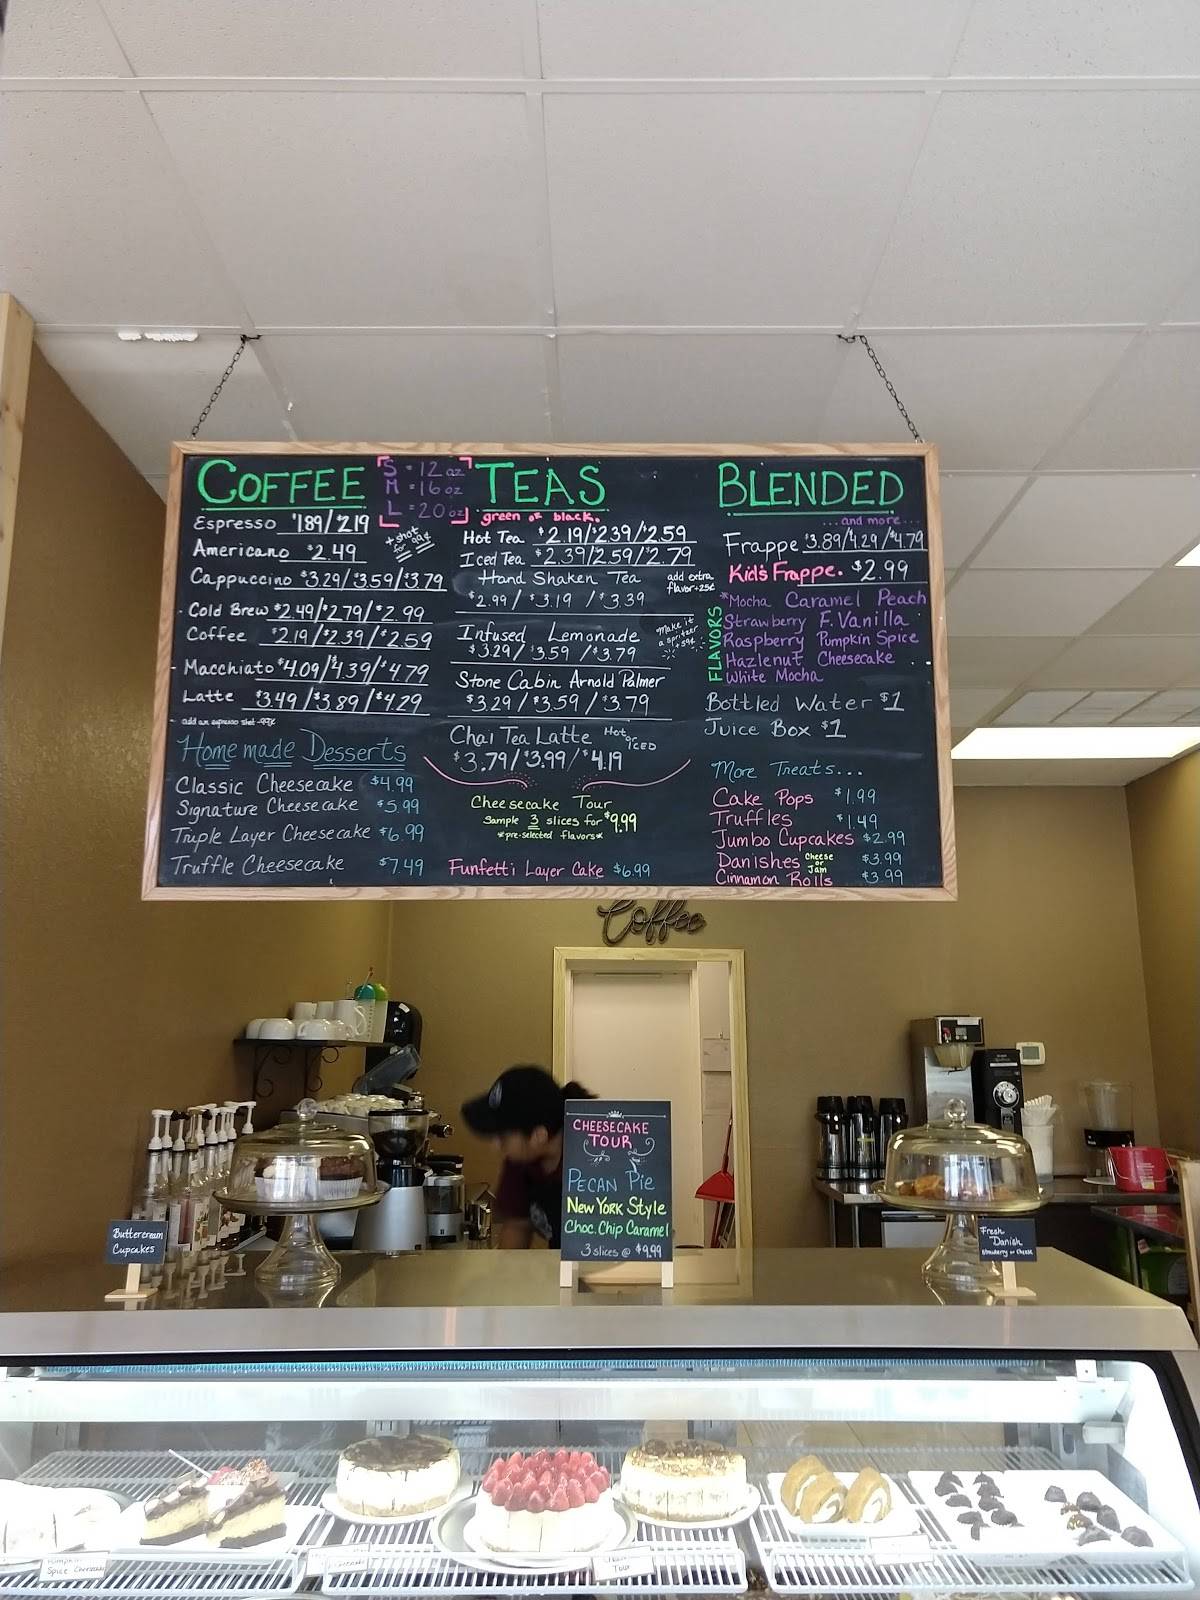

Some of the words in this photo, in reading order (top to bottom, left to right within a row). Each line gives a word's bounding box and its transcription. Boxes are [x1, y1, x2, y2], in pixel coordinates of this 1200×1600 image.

[384, 459, 397, 477] S
[421, 461, 443, 477] 12
[446, 468, 465, 477] oz
[197, 459, 366, 504] COFFEE
[386, 479, 399, 495] M
[420, 480, 441, 496] 16
[445, 487, 463, 495] oz
[475, 462, 606, 506] TEAS
[718, 462, 904, 508] BLENDED
[388, 500, 402, 516] L
[418, 502, 445, 518] 20
[193, 516, 277, 534] Espresso
[481, 512, 521, 527] green
[553, 511, 601, 524] black.
[396, 526, 419, 543] shot
[463, 530, 491, 544] Hot
[497, 530, 525, 544] Tea
[192, 538, 290, 559] Americano
[307, 543, 356, 562] $2.49
[722, 532, 799, 561] Frappe
[460, 551, 498, 567] Iced
[501, 551, 525, 566] Tea
[190, 567, 292, 592] Cappuccino
[478, 569, 527, 585] Hand
[532, 571, 599, 586] Shaken
[607, 571, 641, 584] Tea
[667, 571, 684, 581] add
[688, 570, 714, 581] extra
[852, 559, 909, 582] $2.99
[785, 591, 860, 609] Caramel
[878, 591, 927, 607] Peach
[188, 602, 222, 617] Cold
[230, 603, 269, 616] Brew
[684, 617, 694, 626] it
[723, 613, 807, 634] Strawberry
[839, 610, 909, 629] Vanilla
[186, 626, 248, 643] Coffee
[457, 621, 526, 643] Infused
[548, 621, 640, 643] Lemonade
[667, 625, 699, 646] spritzer
[723, 632, 804, 652] Raspberry
[816, 631, 871, 651] Pumpkin
[876, 629, 920, 649] Spice
[708, 606, 723, 681] FLAVORS
[183, 659, 274, 676] Macchiato
[726, 652, 804, 669] Hazlenut
[817, 650, 895, 667] Cheesecake
[455, 670, 501, 689] Stone
[507, 669, 561, 691] Cabin
[569, 669, 614, 689] Arnold
[618, 669, 665, 689] Palmer
[726, 669, 767, 684] White
[775, 668, 824, 682] Mocha
[183, 689, 234, 703] Latte
[705, 692, 780, 712] Bottled
[795, 693, 872, 712] Water
[880, 691, 904, 711] $1
[450, 725, 494, 747] Chai
[500, 726, 530, 746] Tea
[536, 725, 592, 745] Latte
[604, 727, 627, 738] Hot
[704, 716, 760, 736] Juice
[770, 719, 811, 737] Box
[821, 719, 846, 738] $1
[300, 728, 406, 762] Desserts
[625, 735, 637, 743] or
[711, 760, 757, 783] More
[175, 776, 243, 795] Classic
[257, 773, 353, 793] Cheesecake
[370, 776, 413, 793] $4.99
[471, 796, 560, 811] Cheesecake
[572, 795, 613, 809] Tour
[712, 787, 763, 807] Cake
[774, 788, 814, 810] Pops
[834, 787, 876, 805] $1.99
[177, 799, 258, 824] Signature
[267, 797, 359, 814] Cheesecake
[377, 798, 419, 814] $5.99
[709, 810, 793, 827] Truffles
[836, 813, 877, 829] $1.49
[483, 815, 519, 826] Sample
[530, 815, 539, 825] 3
[547, 816, 580, 826] slices
[585, 815, 603, 826] for
[604, 813, 637, 833] $9.99
[171, 827, 222, 852] Triple
[229, 826, 275, 848] Layer
[283, 823, 371, 842] Cheesecake
[379, 823, 424, 842] $6.99
[712, 829, 770, 849] Jumbo
[779, 828, 854, 852] Cupcakes
[863, 831, 905, 847] $2.99
[170, 854, 234, 875] Truffle
[242, 854, 344, 876] Cheesecake
[379, 856, 424, 876] $7.49
[717, 851, 801, 869] Danishes
[862, 852, 902, 865] $3.99
[805, 852, 834, 861] Cheese
[449, 859, 516, 877] Funfetti
[526, 859, 565, 881] Layer
[572, 861, 604, 879] Cake
[613, 863, 650, 877] $6.99
[715, 869, 779, 885] Cinnamon
[786, 871, 833, 887] Rolls
[862, 870, 903, 886] $3.99
[808, 865, 827, 874] Jam
[573, 1119, 649, 1134] CHEESECAKE
[588, 1134, 632, 1149] TOUR
[568, 1168, 617, 1192] PECAN
[625, 1170, 655, 1191] Pie
[567, 1196, 594, 1214] New
[627, 1196, 667, 1220] Style
[112, 1227, 163, 1240] Buttercream
[598, 1220, 623, 1239] Chip
[626, 1220, 669, 1237] Caramel
[979, 1226, 1005, 1235] Fresh
[112, 1242, 155, 1257] Cupcakes
[989, 1236, 1023, 1246] Danish
[581, 1243, 591, 1257] 3
[593, 1245, 619, 1257] slices
[621, 1248, 631, 1257] @
[635, 1243, 662, 1258] $9.99
